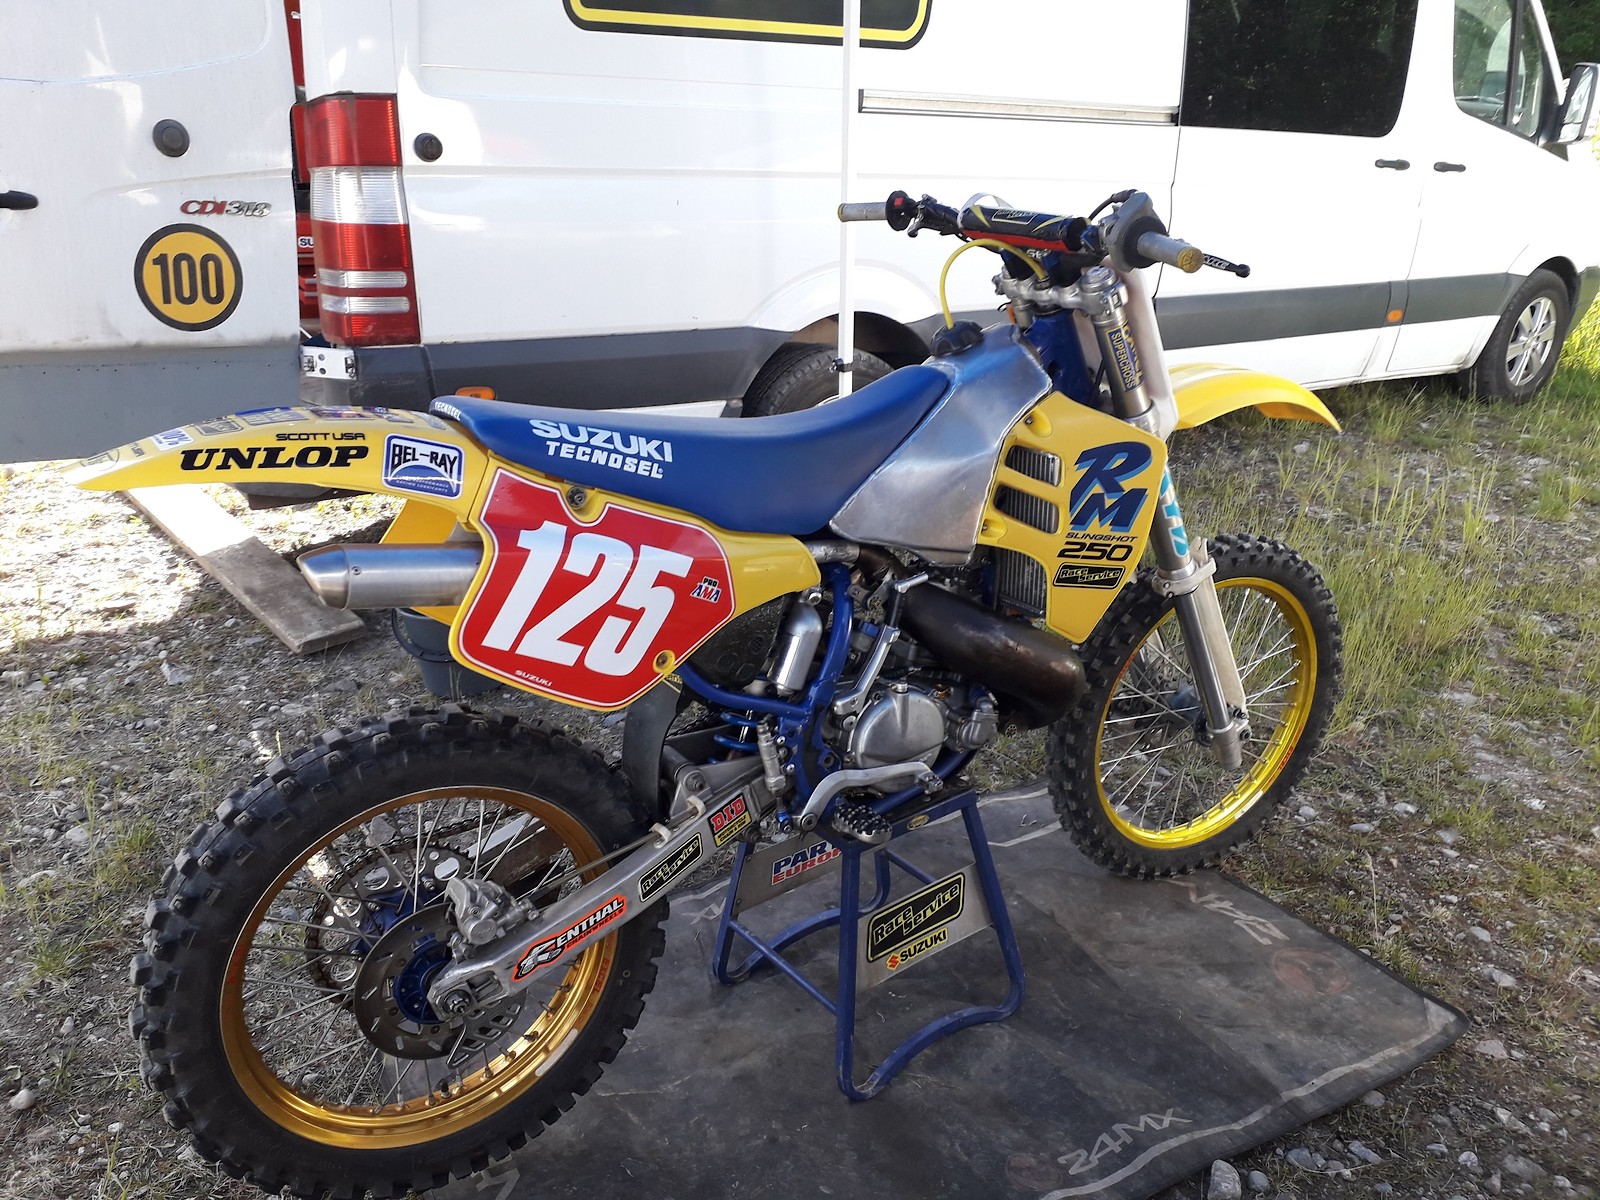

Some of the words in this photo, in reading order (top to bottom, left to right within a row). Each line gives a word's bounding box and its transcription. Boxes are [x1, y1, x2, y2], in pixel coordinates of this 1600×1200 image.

[152, 253, 224, 305] 100
[1110, 331, 1136, 389] SUPERCROSS
[275, 432, 331, 442] SCOTT
[332, 432, 366, 441] USA
[529, 418, 673, 463] SUZUKI
[180, 445, 370, 471] UNLOP
[390, 443, 458, 477] BEL-RAY
[545, 440, 664, 479] TECNOSEL
[1056, 541, 1134, 562] 250
[1065, 531, 1138, 543] SLINGSHOT
[702, 577, 718, 588] PRO
[1059, 567, 1089, 579] Race
[1077, 569, 1121, 583] Service
[481, 520, 694, 677] 125
[691, 584, 721, 602] AMA
[515, 669, 553, 687] SUZUKI
[773, 841, 828, 875] PAR
[872, 905, 913, 945] Race
[902, 884, 960, 936] Service
[899, 929, 948, 962] SUZUKI
[1057, 1108, 1193, 1176] 24MX
